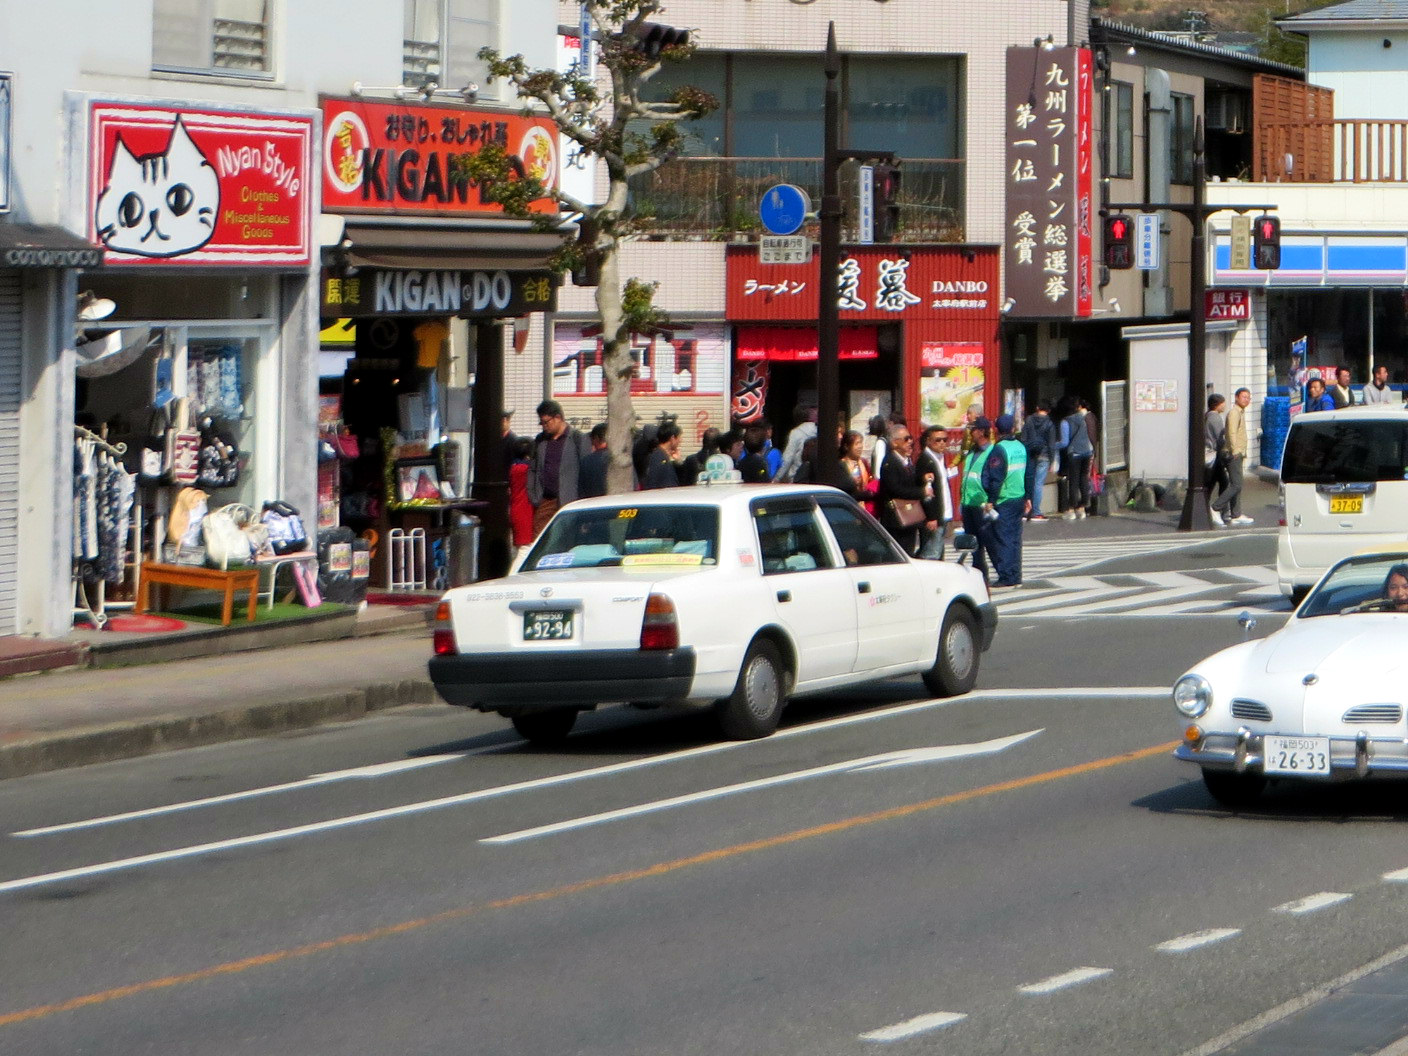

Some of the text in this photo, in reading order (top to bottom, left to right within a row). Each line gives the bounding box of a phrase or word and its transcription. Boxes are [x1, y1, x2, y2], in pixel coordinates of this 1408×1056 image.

[1080, 63, 1089, 175] ラーメン
[216, 140, 300, 198] Nyan Style
[1012, 102, 1038, 265] 第一位 受賞
[1043, 63, 1069, 302] 九州ラーメン総選挙
[241, 185, 280, 203] Clothes
[256, 203, 264, 212] &
[223, 210, 291, 225] Miscellaneous
[242, 224, 274, 239] Goods
[763, 251, 802, 261] ここまで
[375, 271, 512, 312] KIGAN DO
[523, 277, 551, 302] 合格
[744, 279, 806, 295] ラーメン
[932, 280, 988, 293] DANBO
[1212, 292, 1244, 304] 銀行
[1209, 304, 1245, 316] ATM
[618, 508, 639, 519] 503
[533, 621, 572, 639] 92-94
[1280, 739, 1315, 751] 福岡 503
[1278, 751, 1327, 771] 26-33
